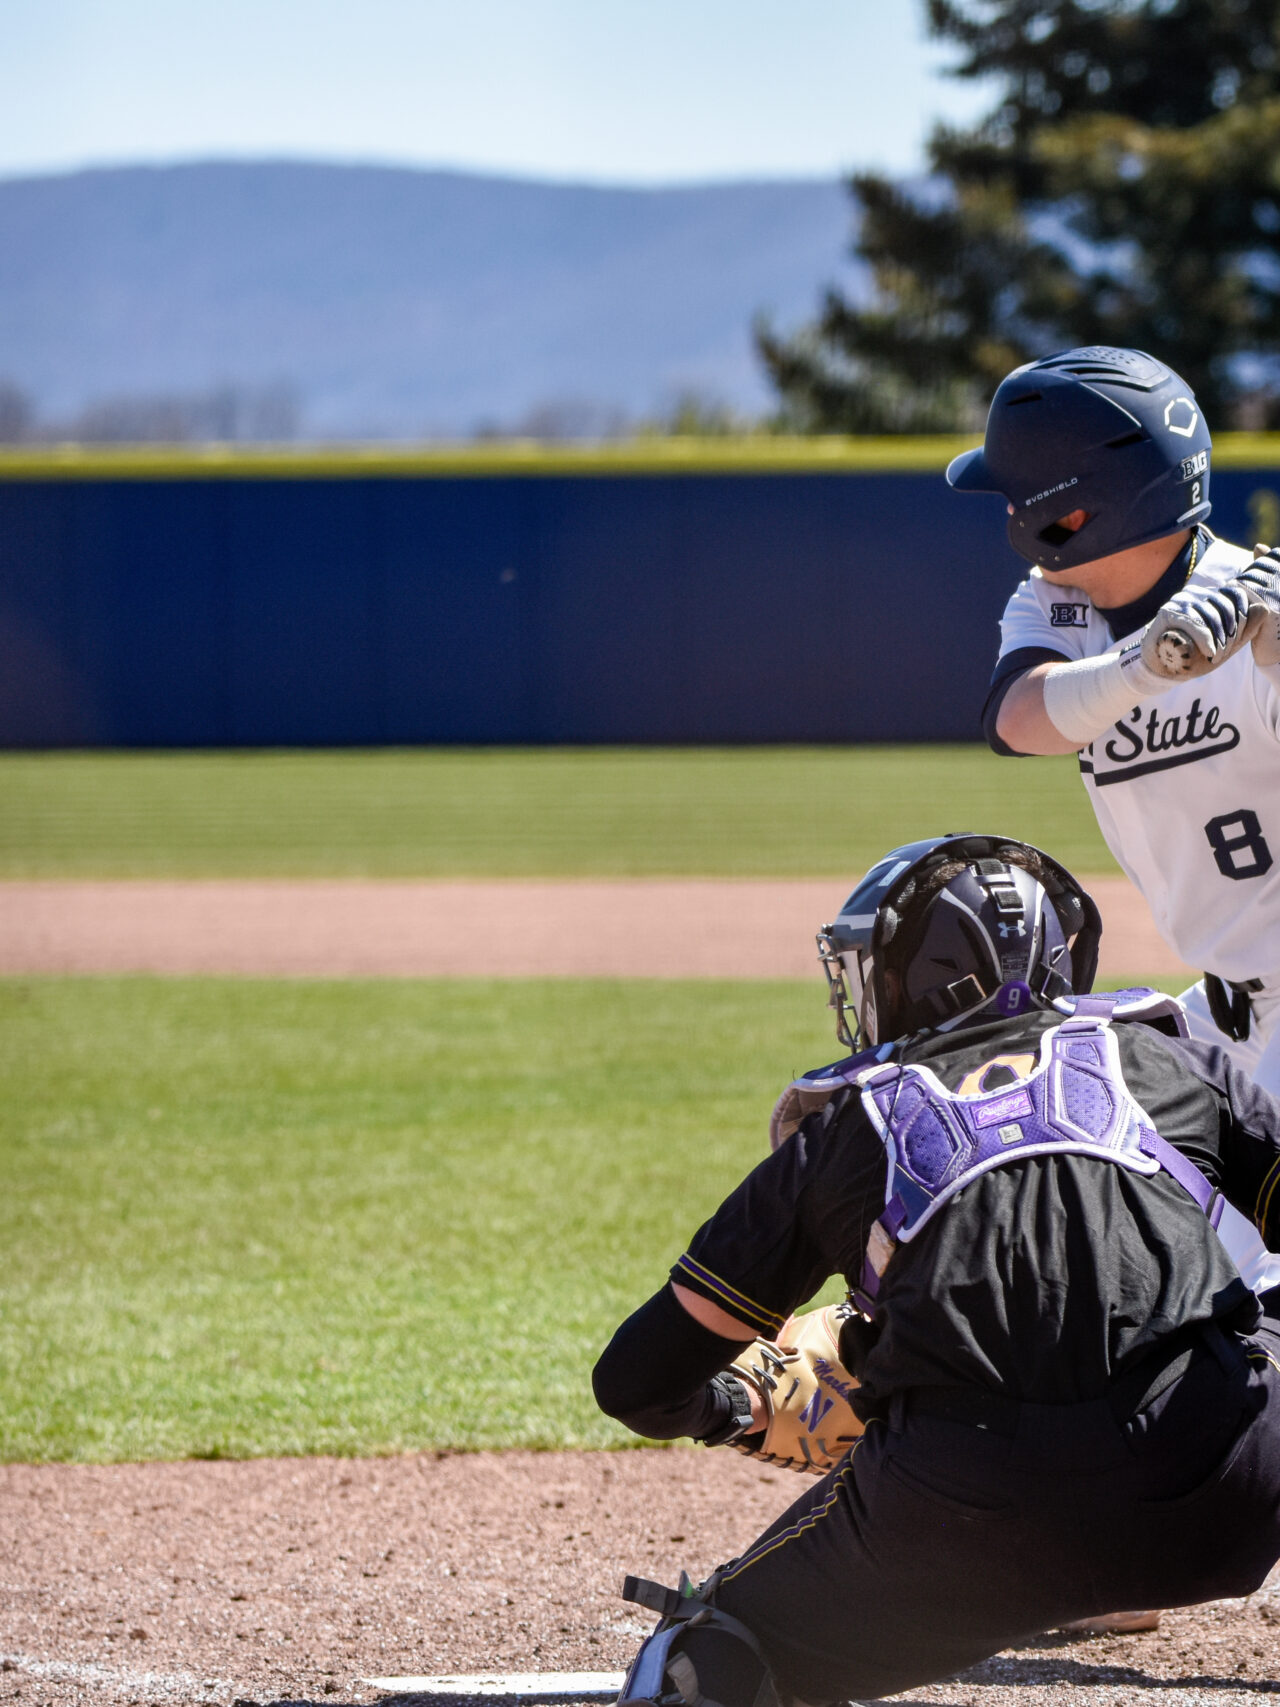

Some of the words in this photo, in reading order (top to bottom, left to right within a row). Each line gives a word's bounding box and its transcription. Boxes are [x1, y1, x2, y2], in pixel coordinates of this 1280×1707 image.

[1192, 481, 1201, 505] 2
[1105, 698, 1230, 763] State
[1204, 808, 1274, 881] 8
[1007, 987, 1021, 1009] 9
[798, 1386, 835, 1434] N
